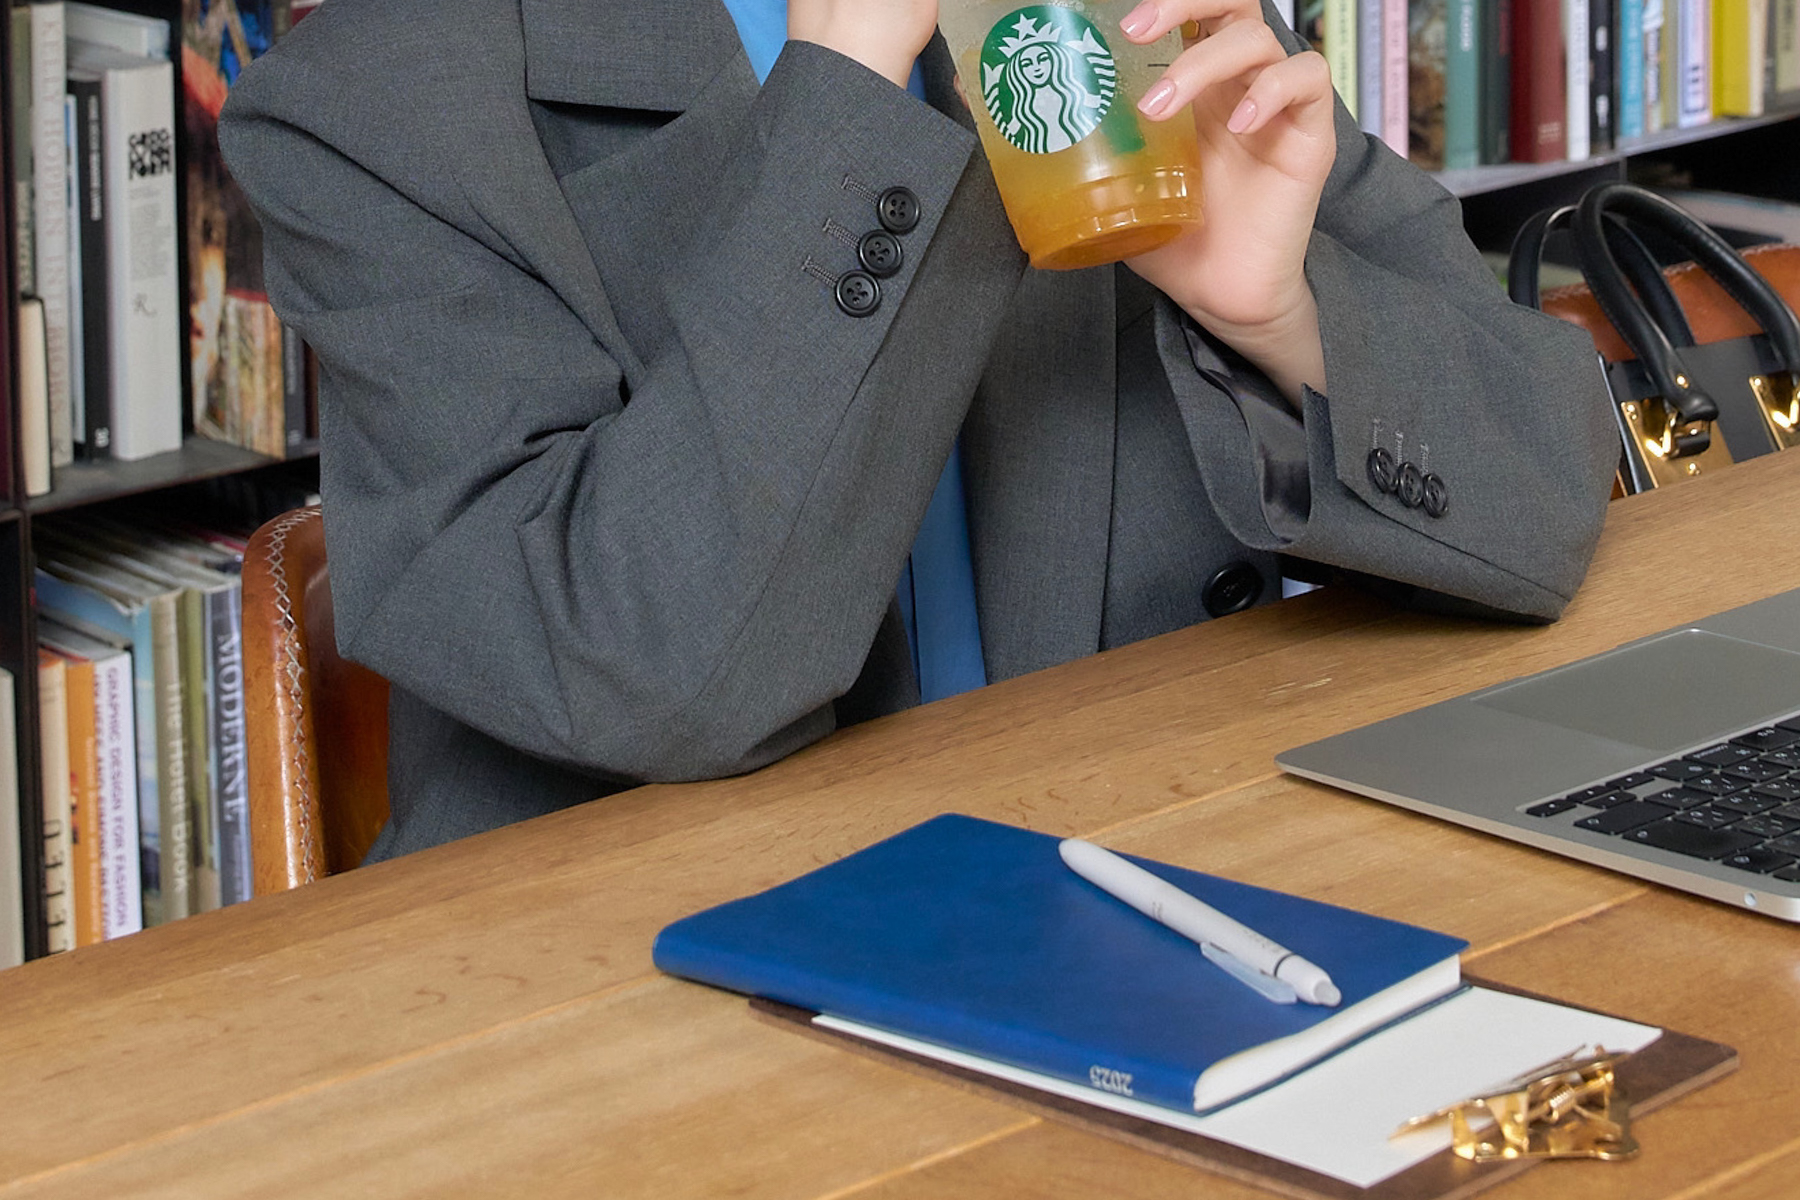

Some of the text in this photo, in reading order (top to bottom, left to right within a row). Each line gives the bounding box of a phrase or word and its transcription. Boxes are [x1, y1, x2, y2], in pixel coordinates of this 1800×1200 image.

[42, 19, 63, 104] KELLY
[44, 119, 65, 237] HOPPEN
[106, 668, 128, 928] GRAPHIC DESIGN FOR FASHION
[167, 681, 193, 894] The Hotel Book
[217, 632, 247, 823] MODERNE
[1089, 1064, 1134, 1097] 2025
